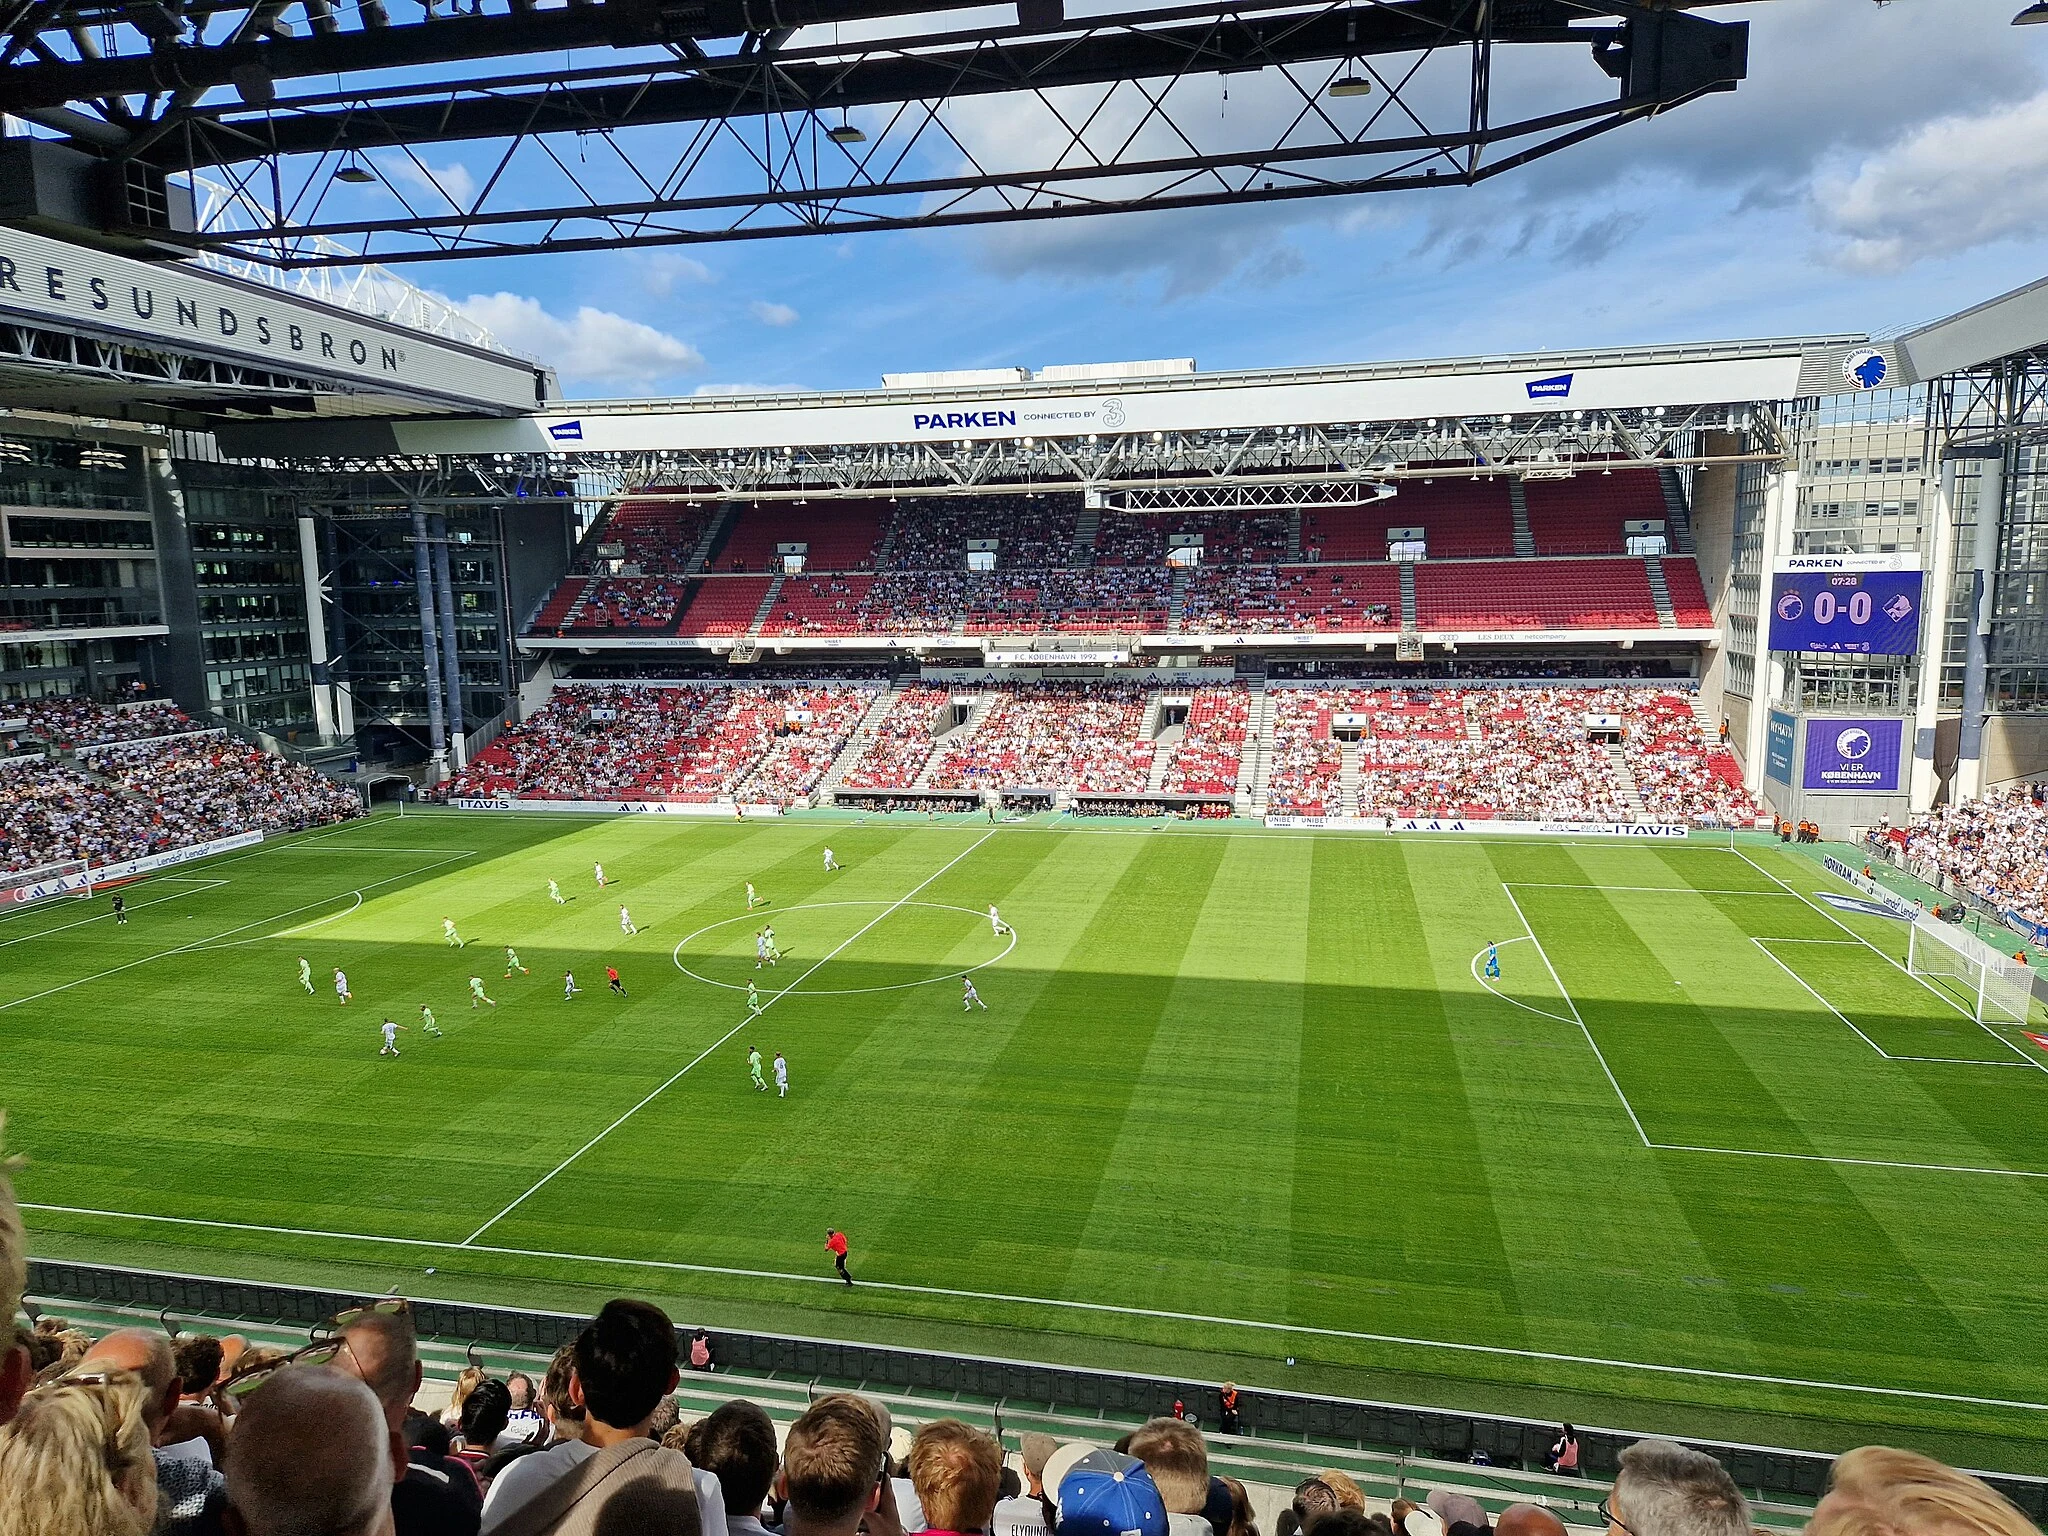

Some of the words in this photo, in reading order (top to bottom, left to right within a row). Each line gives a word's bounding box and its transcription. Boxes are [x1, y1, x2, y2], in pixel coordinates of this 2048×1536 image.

[1531, 384, 1567, 392] PARKEN
[914, 411, 1016, 429] PARKEN
[1024, 412, 1081, 421] CONNECTED
[1083, 411, 1096, 419] BY
[1789, 559, 1843, 568] PARKEN
[1831, 577, 1857, 586] 07:28
[1821, 771, 1881, 780] KØBENHAVN
[460, 800, 509, 809] ITAVIS
[1615, 825, 1685, 836] ITAVIS
[184, 845, 208, 859] Lendo
[157, 852, 181, 867] Lendo
